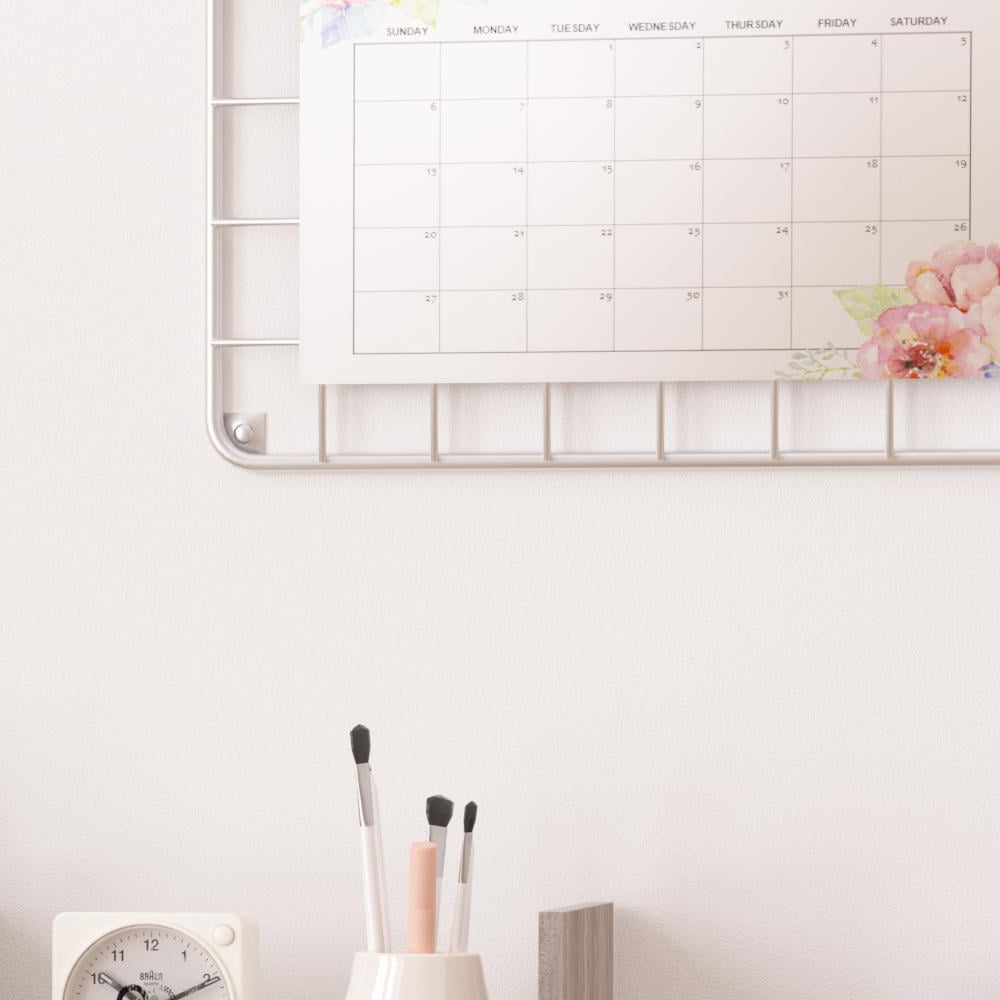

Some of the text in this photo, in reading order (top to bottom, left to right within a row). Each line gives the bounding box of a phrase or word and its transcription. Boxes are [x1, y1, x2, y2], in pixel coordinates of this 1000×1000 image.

[386, 15, 948, 37] SUNDAY MONDAY TUESDAY WEDNESDAY THURSDAY FRIDAY SATURDAY
[784, 40, 791, 50] 3
[871, 38, 878, 48] 4
[961, 37, 967, 47] 5
[430, 102, 437, 112] 6
[606, 99, 613, 109] 8
[694, 99, 702, 109] 9
[777, 97, 789, 106] 10
[869, 96, 879, 104] 11
[956, 95, 968, 103] 12
[426, 159, 967, 177] 13 14 15 16 17 18 19
[424, 222, 967, 239] 20 21 22 23 24 25 26
[424, 290, 789, 304] 27 28 29 30 31
[143, 939, 159, 951] 12
[111, 951, 125, 962] 11
[182, 952, 187, 962] 1
[91, 973, 107, 985] 10
[202, 974, 213, 987] 2
